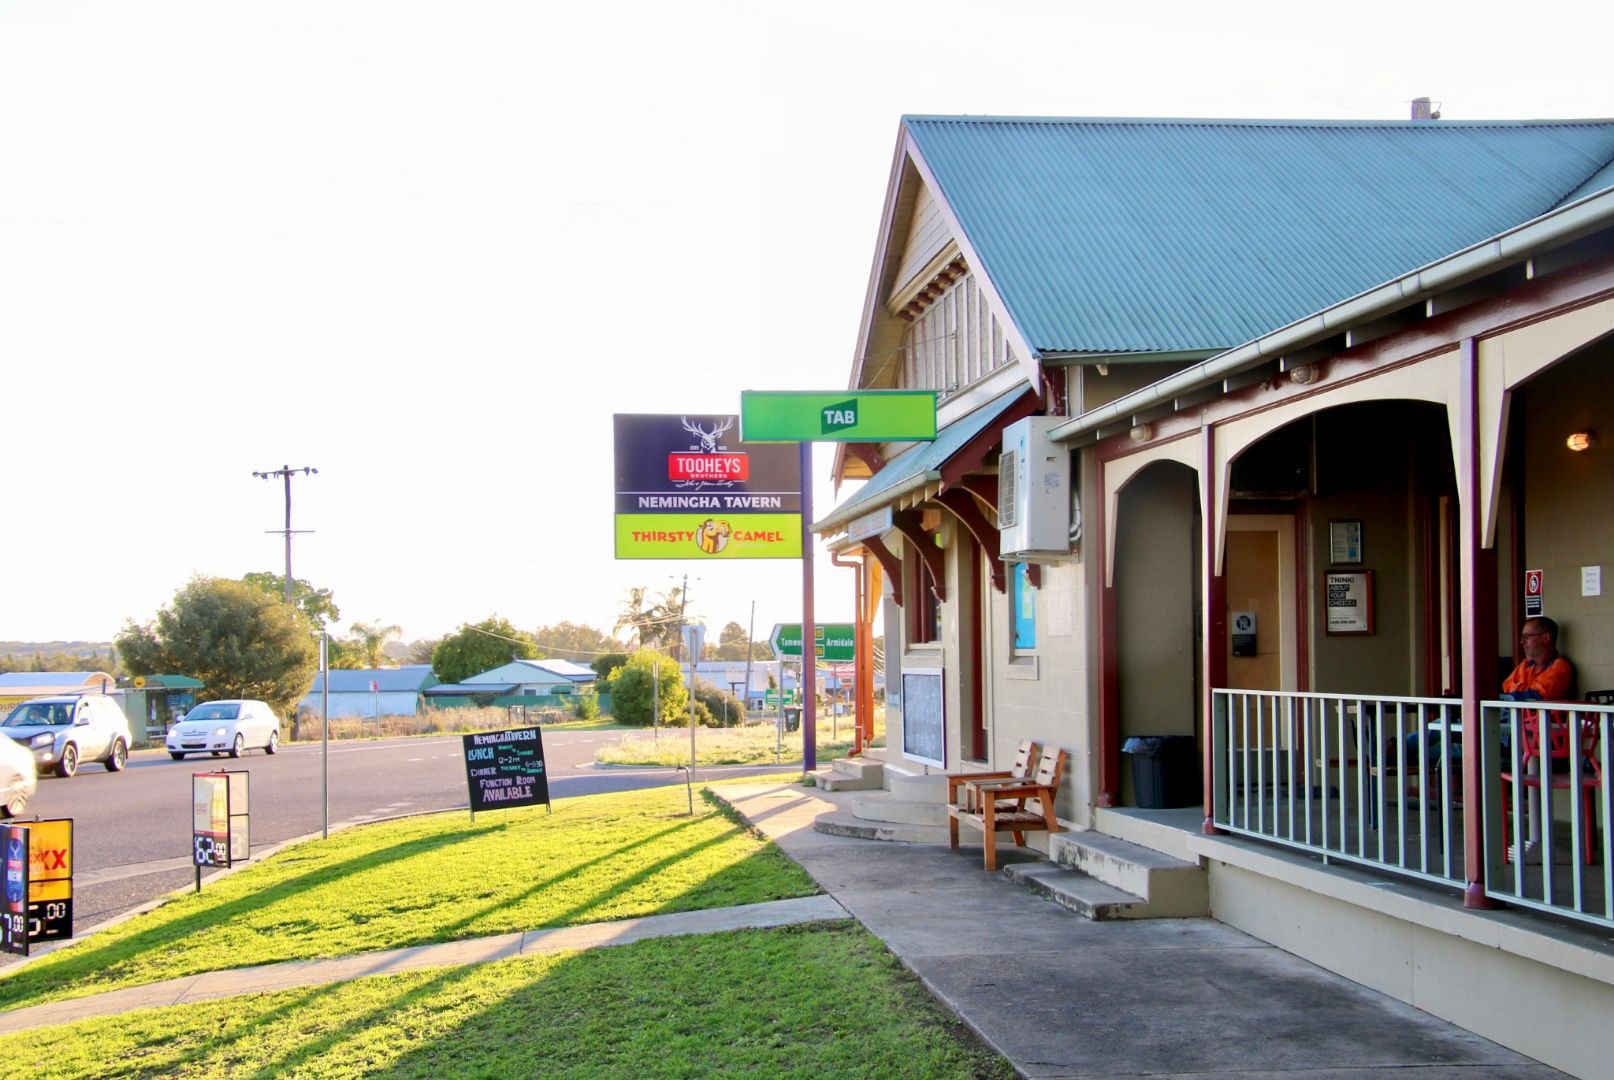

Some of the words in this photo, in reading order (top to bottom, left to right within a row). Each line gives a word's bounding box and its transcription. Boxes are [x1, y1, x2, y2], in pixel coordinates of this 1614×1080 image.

[823, 410, 855, 424] TAB
[677, 458, 741, 473] TOOHEYS
[638, 496, 721, 508] NEMINGHA
[724, 496, 781, 508] TAVERN
[632, 530, 694, 542] THIRSTY
[733, 530, 784, 542] CAMEL
[826, 638, 853, 646] Armidale
[471, 768, 496, 776] DINNER
[480, 778, 512, 788] FUNCTION
[516, 776, 535, 785] ROOM
[483, 786, 532, 802] AVAILABLE
